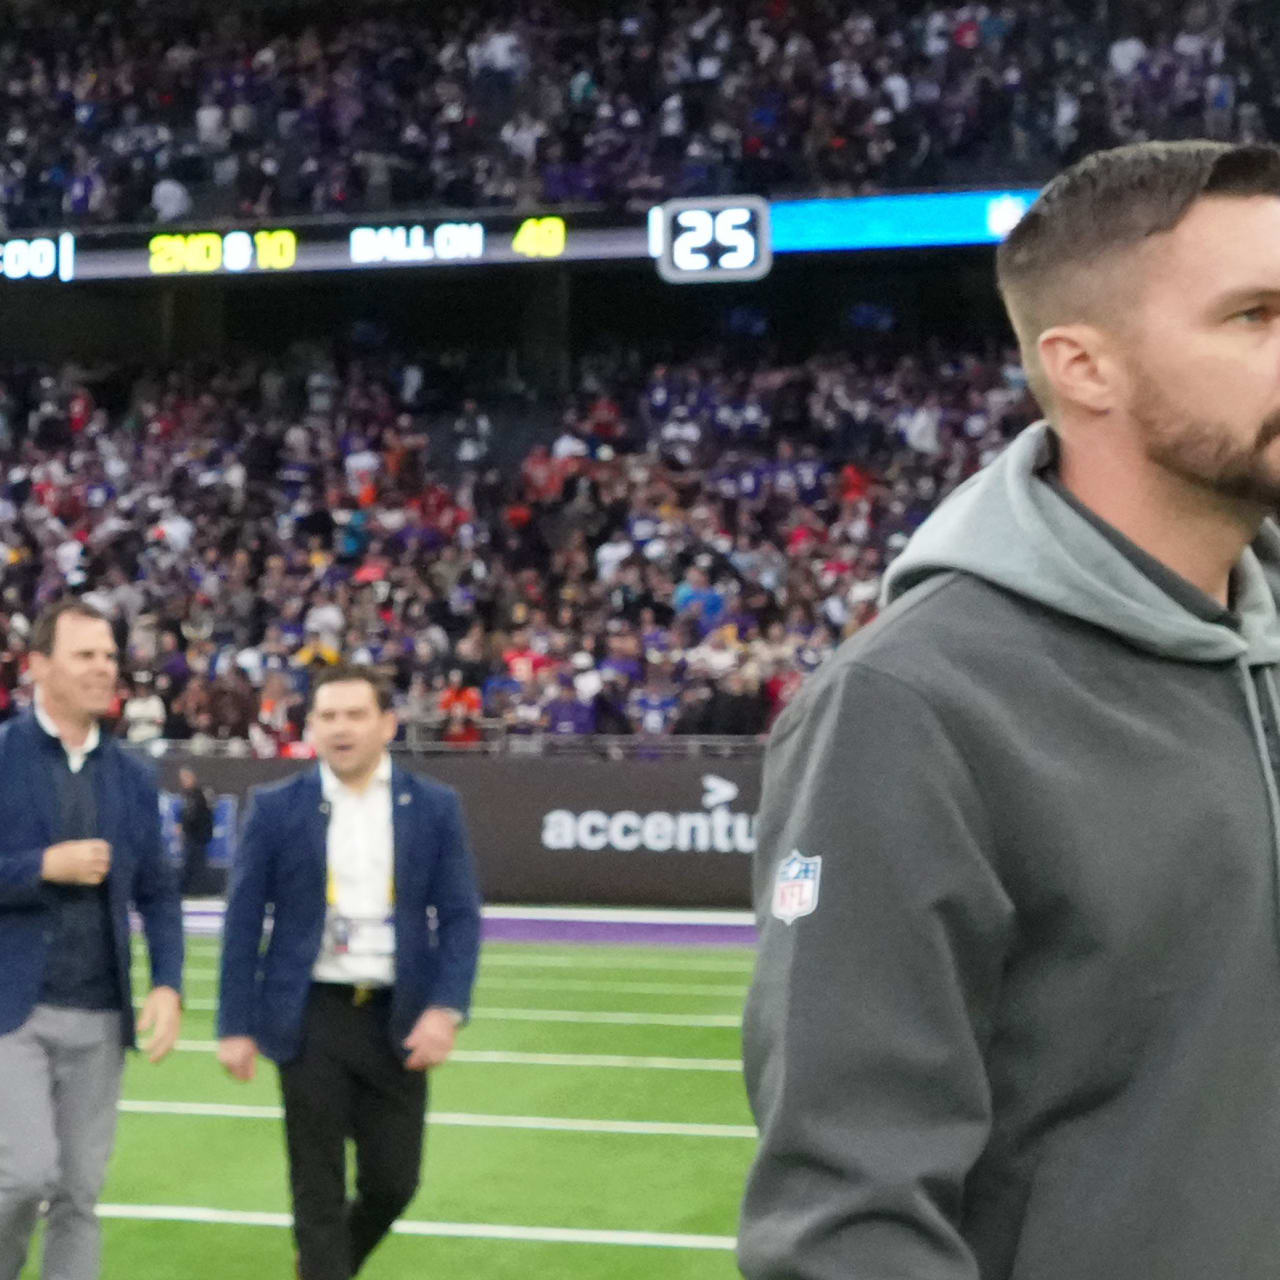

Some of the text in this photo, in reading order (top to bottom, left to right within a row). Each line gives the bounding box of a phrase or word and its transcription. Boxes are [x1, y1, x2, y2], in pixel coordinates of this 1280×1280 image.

[350, 226, 434, 263] BALL
[434, 223, 483, 259] ON
[672, 208, 755, 270] 25
